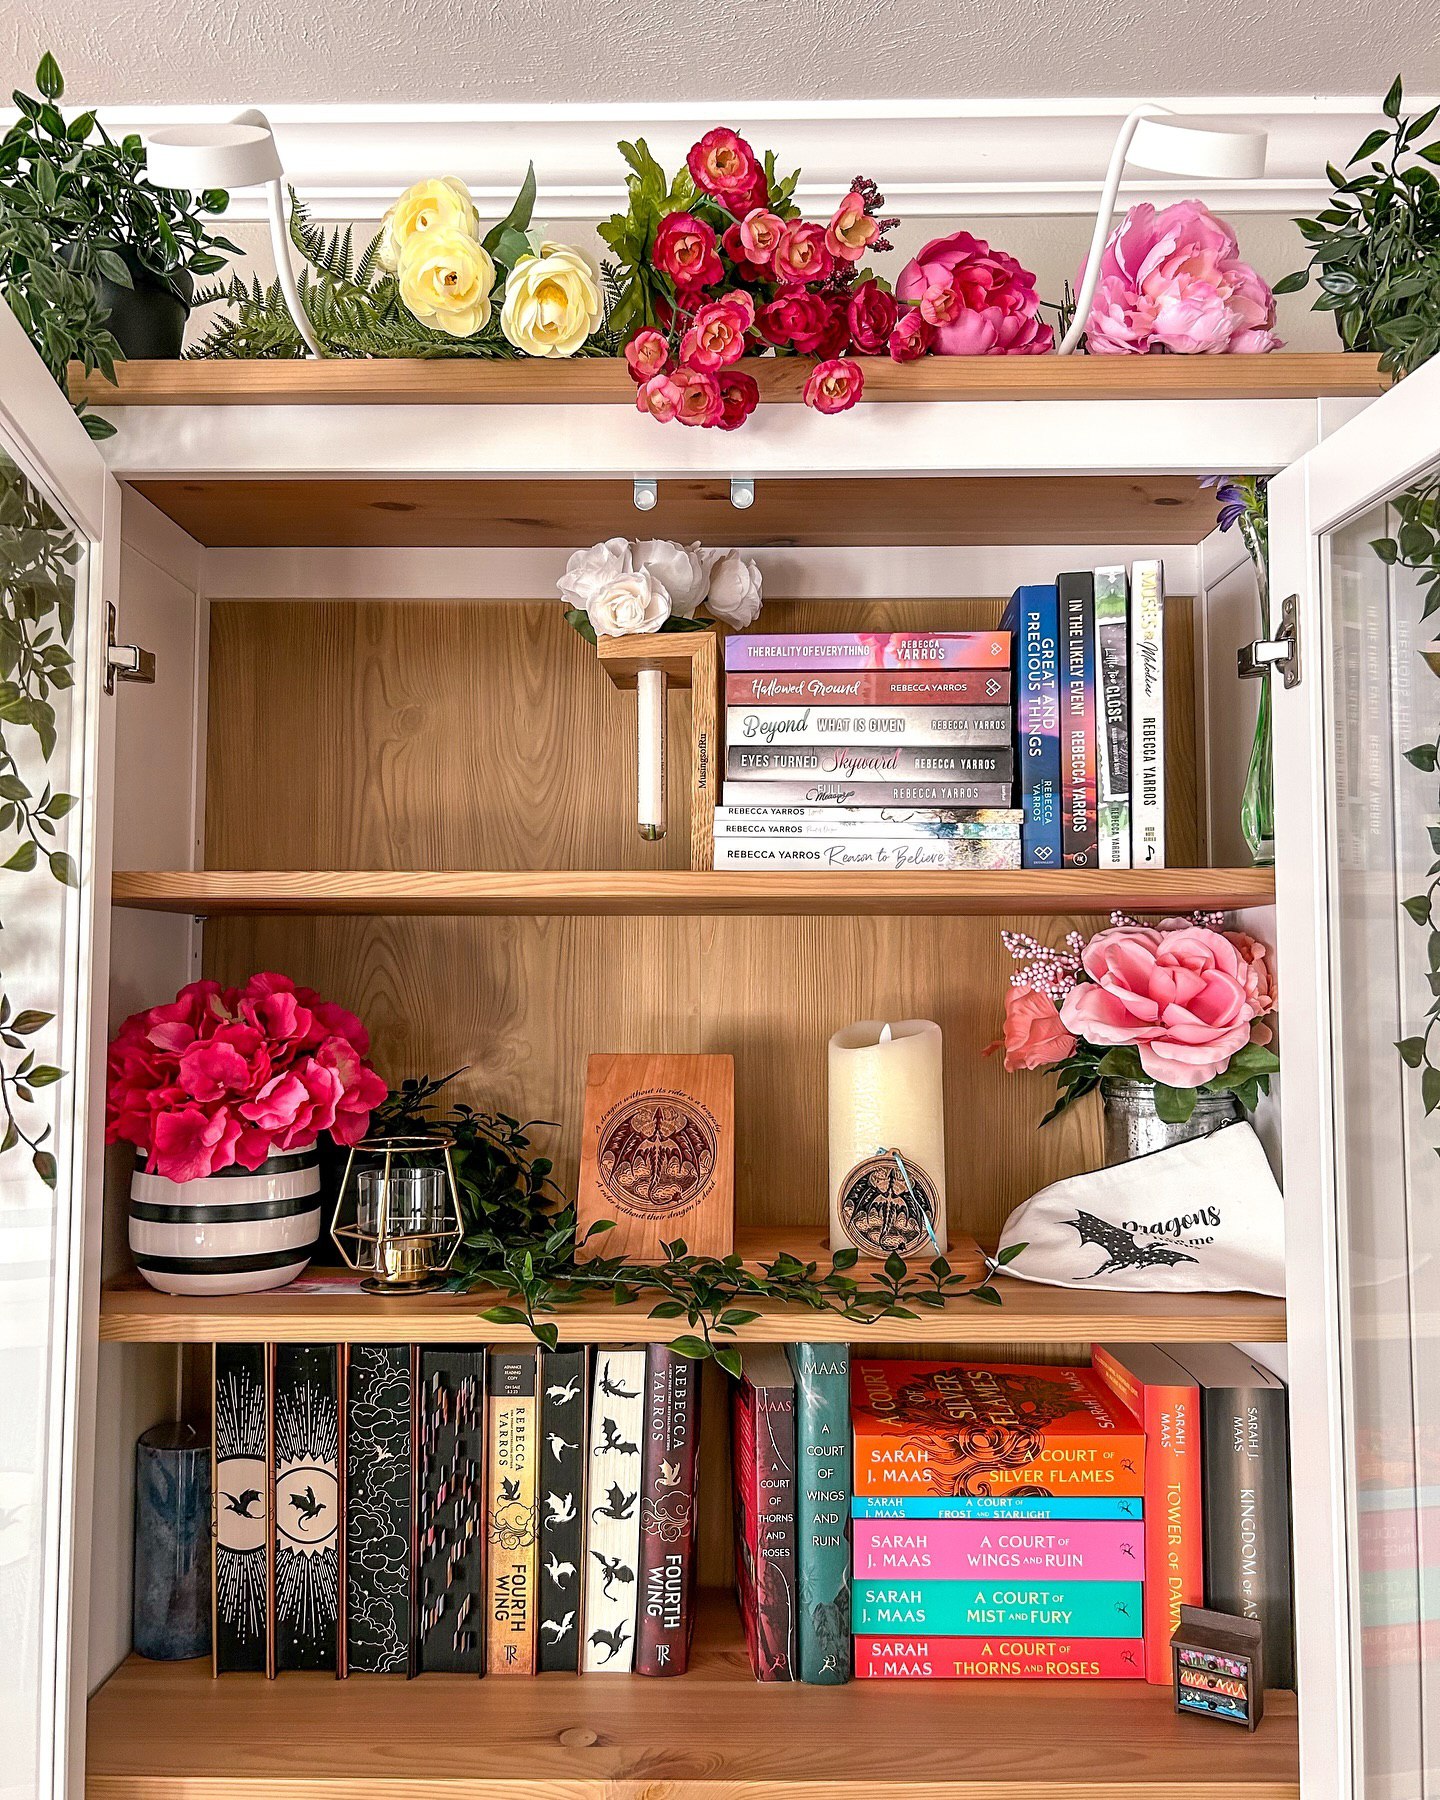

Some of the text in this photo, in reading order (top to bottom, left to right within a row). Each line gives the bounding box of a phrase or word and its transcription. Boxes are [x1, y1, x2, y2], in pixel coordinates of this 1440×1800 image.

[814, 645, 870, 656] EVERYTHING
[901, 639, 940, 649] REBECCA
[896, 647, 945, 660] YARROS
[1068, 600, 1085, 716] IN THE LIKELY EVENT
[1136, 641, 1159, 698] Melodies
[751, 678, 861, 699] Hallowed Ground
[931, 683, 967, 691] YARROS
[1027, 611, 1042, 757] PRECIOUS THINGS
[1041, 638, 1056, 729] GREAT AND
[1106, 685, 1122, 724] CLOSE
[743, 708, 906, 743] Beyond WHAT IS GIVEN
[930, 719, 1006, 731] REBECCA YARROS
[741, 747, 900, 778] EYES TURNED Skyward
[914, 757, 996, 770] REBECCA YARROS
[1142, 718, 1157, 807] REBECCA YARROS
[1070, 731, 1087, 833] REBECCA YARROS
[893, 788, 979, 799] REBECCA YARROS
[1032, 783, 1042, 822] YARROS
[1043, 780, 1053, 825] REBECCA
[728, 807, 769, 816] REBECCA
[770, 807, 805, 816] YARROS
[726, 824, 766, 833] REBECCA
[767, 824, 803, 834] YARROS
[727, 845, 945, 869] REBECCA YARROS Reason to Believe
[1110, 837, 1120, 863] YARROS
[623, 1088, 654, 1102] without
[614, 1203, 646, 1220] without
[646, 1213, 666, 1221] their
[666, 1203, 695, 1220] dragon
[1121, 1205, 1221, 1237] Dragons
[803, 1359, 847, 1376] MAAS
[932, 1372, 979, 1422] SILVER
[652, 1370, 666, 1442] YARROS
[672, 1364, 688, 1449] REBECCA
[758, 1400, 792, 1413] MAAS
[1081, 1399, 1116, 1429] SARAH
[821, 1423, 831, 1434] A
[1160, 1412, 1171, 1449] MAAS
[1174, 1403, 1186, 1458] SARAH J.
[1233, 1415, 1245, 1452] MAAS
[1247, 1406, 1259, 1461] SARAH J.
[499, 1412, 509, 1468] YARROS
[515, 1407, 526, 1472] REBECCA
[806, 1445, 845, 1457] COURT
[870, 1449, 929, 1463] SARAH
[1022, 1449, 1115, 1463] A COURT OF
[770, 1462, 780, 1472] A
[817, 1468, 834, 1480] OF
[867, 1469, 933, 1484] J. MAAS
[989, 1470, 1116, 1484] SILVER FLAMES
[760, 1479, 791, 1489] COURT
[768, 1496, 782, 1506] OF
[806, 1490, 846, 1502] WINGS
[867, 1498, 904, 1507] SARAH
[965, 1498, 974, 1507] A
[976, 1498, 1014, 1507] COURT
[757, 1513, 794, 1523] THORNS
[812, 1513, 839, 1525] AND
[874, 1509, 906, 1519] MAAS
[938, 1510, 972, 1519] FROST
[993, 1510, 1051, 1519] STARLIGHT
[765, 1530, 786, 1540] AND
[811, 1535, 841, 1547] RUIN
[870, 1535, 928, 1548] SARAH
[980, 1535, 1070, 1548] A COURT OF
[1240, 1489, 1257, 1596] KINGDOM OF
[761, 1547, 791, 1558] ROSES
[1166, 1481, 1184, 1633] TOWER OF DAWN
[867, 1553, 932, 1568] J. MAAS
[966, 1553, 1084, 1567] WINGS AND RUIN
[494, 1574, 510, 1622] WING
[511, 1564, 527, 1632] FOURTH
[646, 1565, 664, 1618] WING
[663, 1554, 682, 1630] FOURTH
[864, 1590, 922, 1604] SARAH
[974, 1591, 1064, 1605] A COURT OF
[861, 1609, 926, 1623] J. MAAS
[966, 1609, 1073, 1624] MIST AND FURY
[871, 1642, 929, 1656] SARAH
[980, 1642, 1071, 1656] A COURT OF
[868, 1661, 933, 1676] J. MAAS
[952, 1661, 1100, 1675] THORNS AND ROSES
